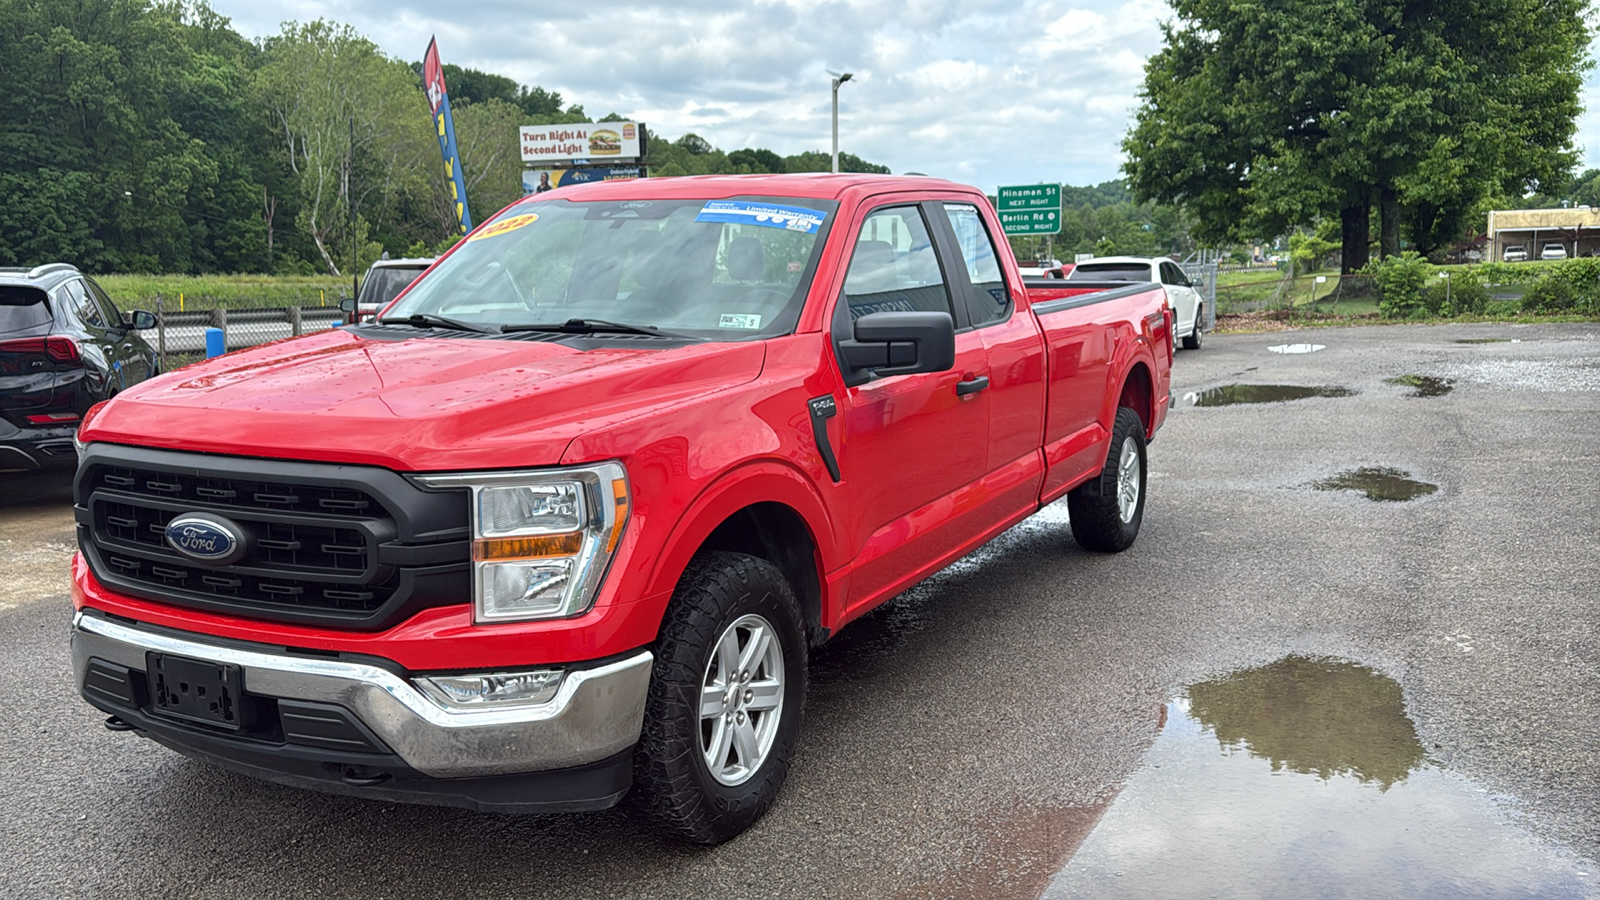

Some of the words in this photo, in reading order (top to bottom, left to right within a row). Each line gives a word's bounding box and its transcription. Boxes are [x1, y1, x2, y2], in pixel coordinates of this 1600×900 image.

[522, 132, 547, 142] Turn
[549, 130, 575, 142] Right
[576, 130, 587, 140] At
[523, 144, 556, 155] Second
[558, 143, 583, 155] Light
[1002, 189, 1042, 197] Hinzman
[1045, 187, 1056, 195] St
[746, 205, 778, 214] Limited
[779, 209, 818, 220] Warranty
[1002, 214, 1029, 222] Berlin
[1033, 212, 1044, 220] Rd
[474, 215, 534, 238] 2022
[180, 526, 217, 551] Ford
